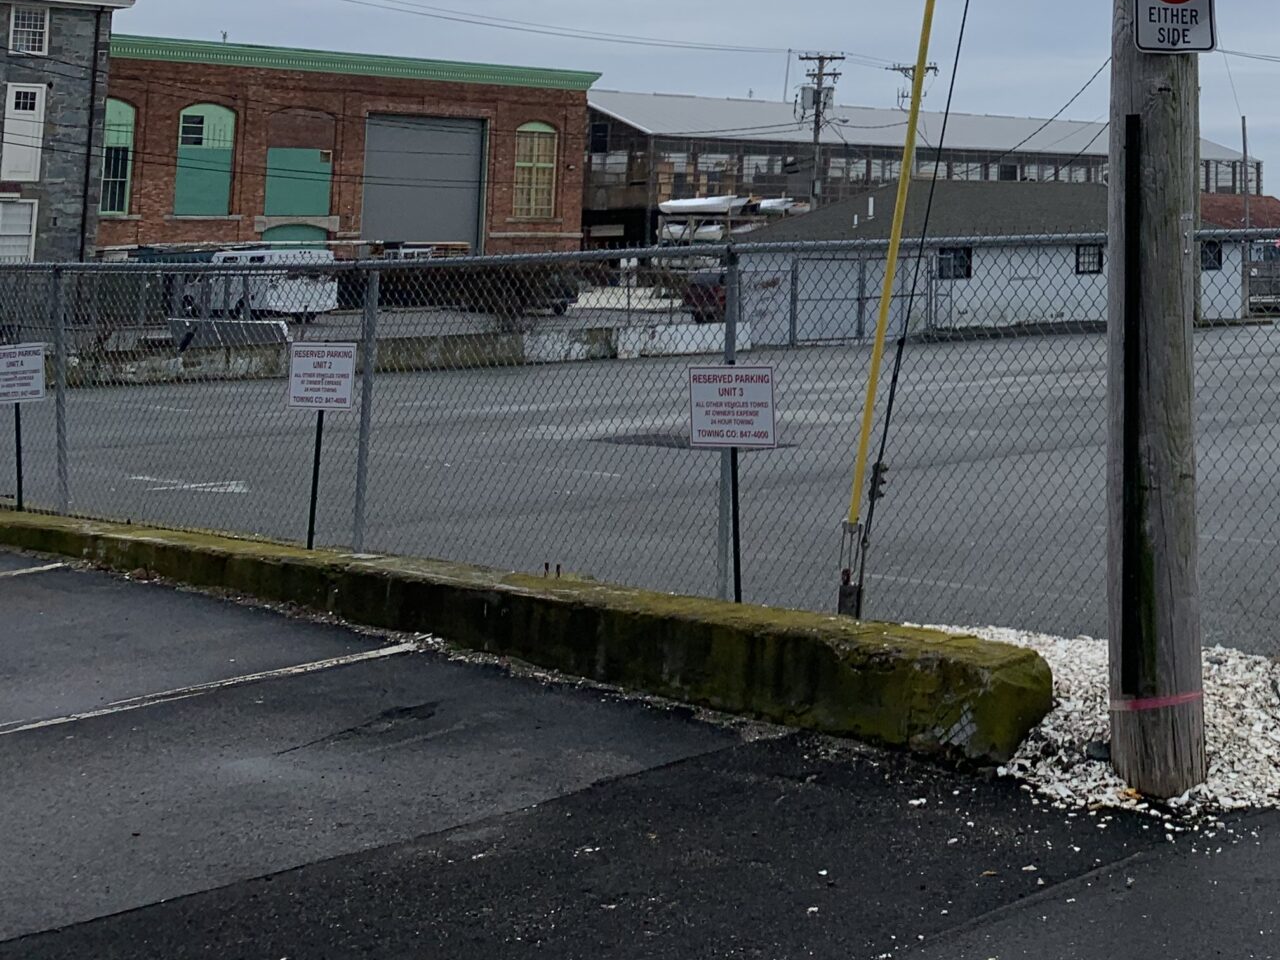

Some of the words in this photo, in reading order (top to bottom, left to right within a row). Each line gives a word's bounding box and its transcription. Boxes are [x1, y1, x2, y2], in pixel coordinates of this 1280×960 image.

[1148, 6, 1199, 25] EITHER
[1157, 27, 1191, 45] SIDE
[294, 350, 326, 359] RESERVED
[326, 350, 353, 359] PARKING
[328, 361, 333, 369] 2
[692, 374, 733, 384] RESERVED
[735, 374, 770, 384] PARKING
[718, 387, 737, 397] UNIT
[738, 387, 744, 397] 3
[697, 430, 724, 439] TOWING
